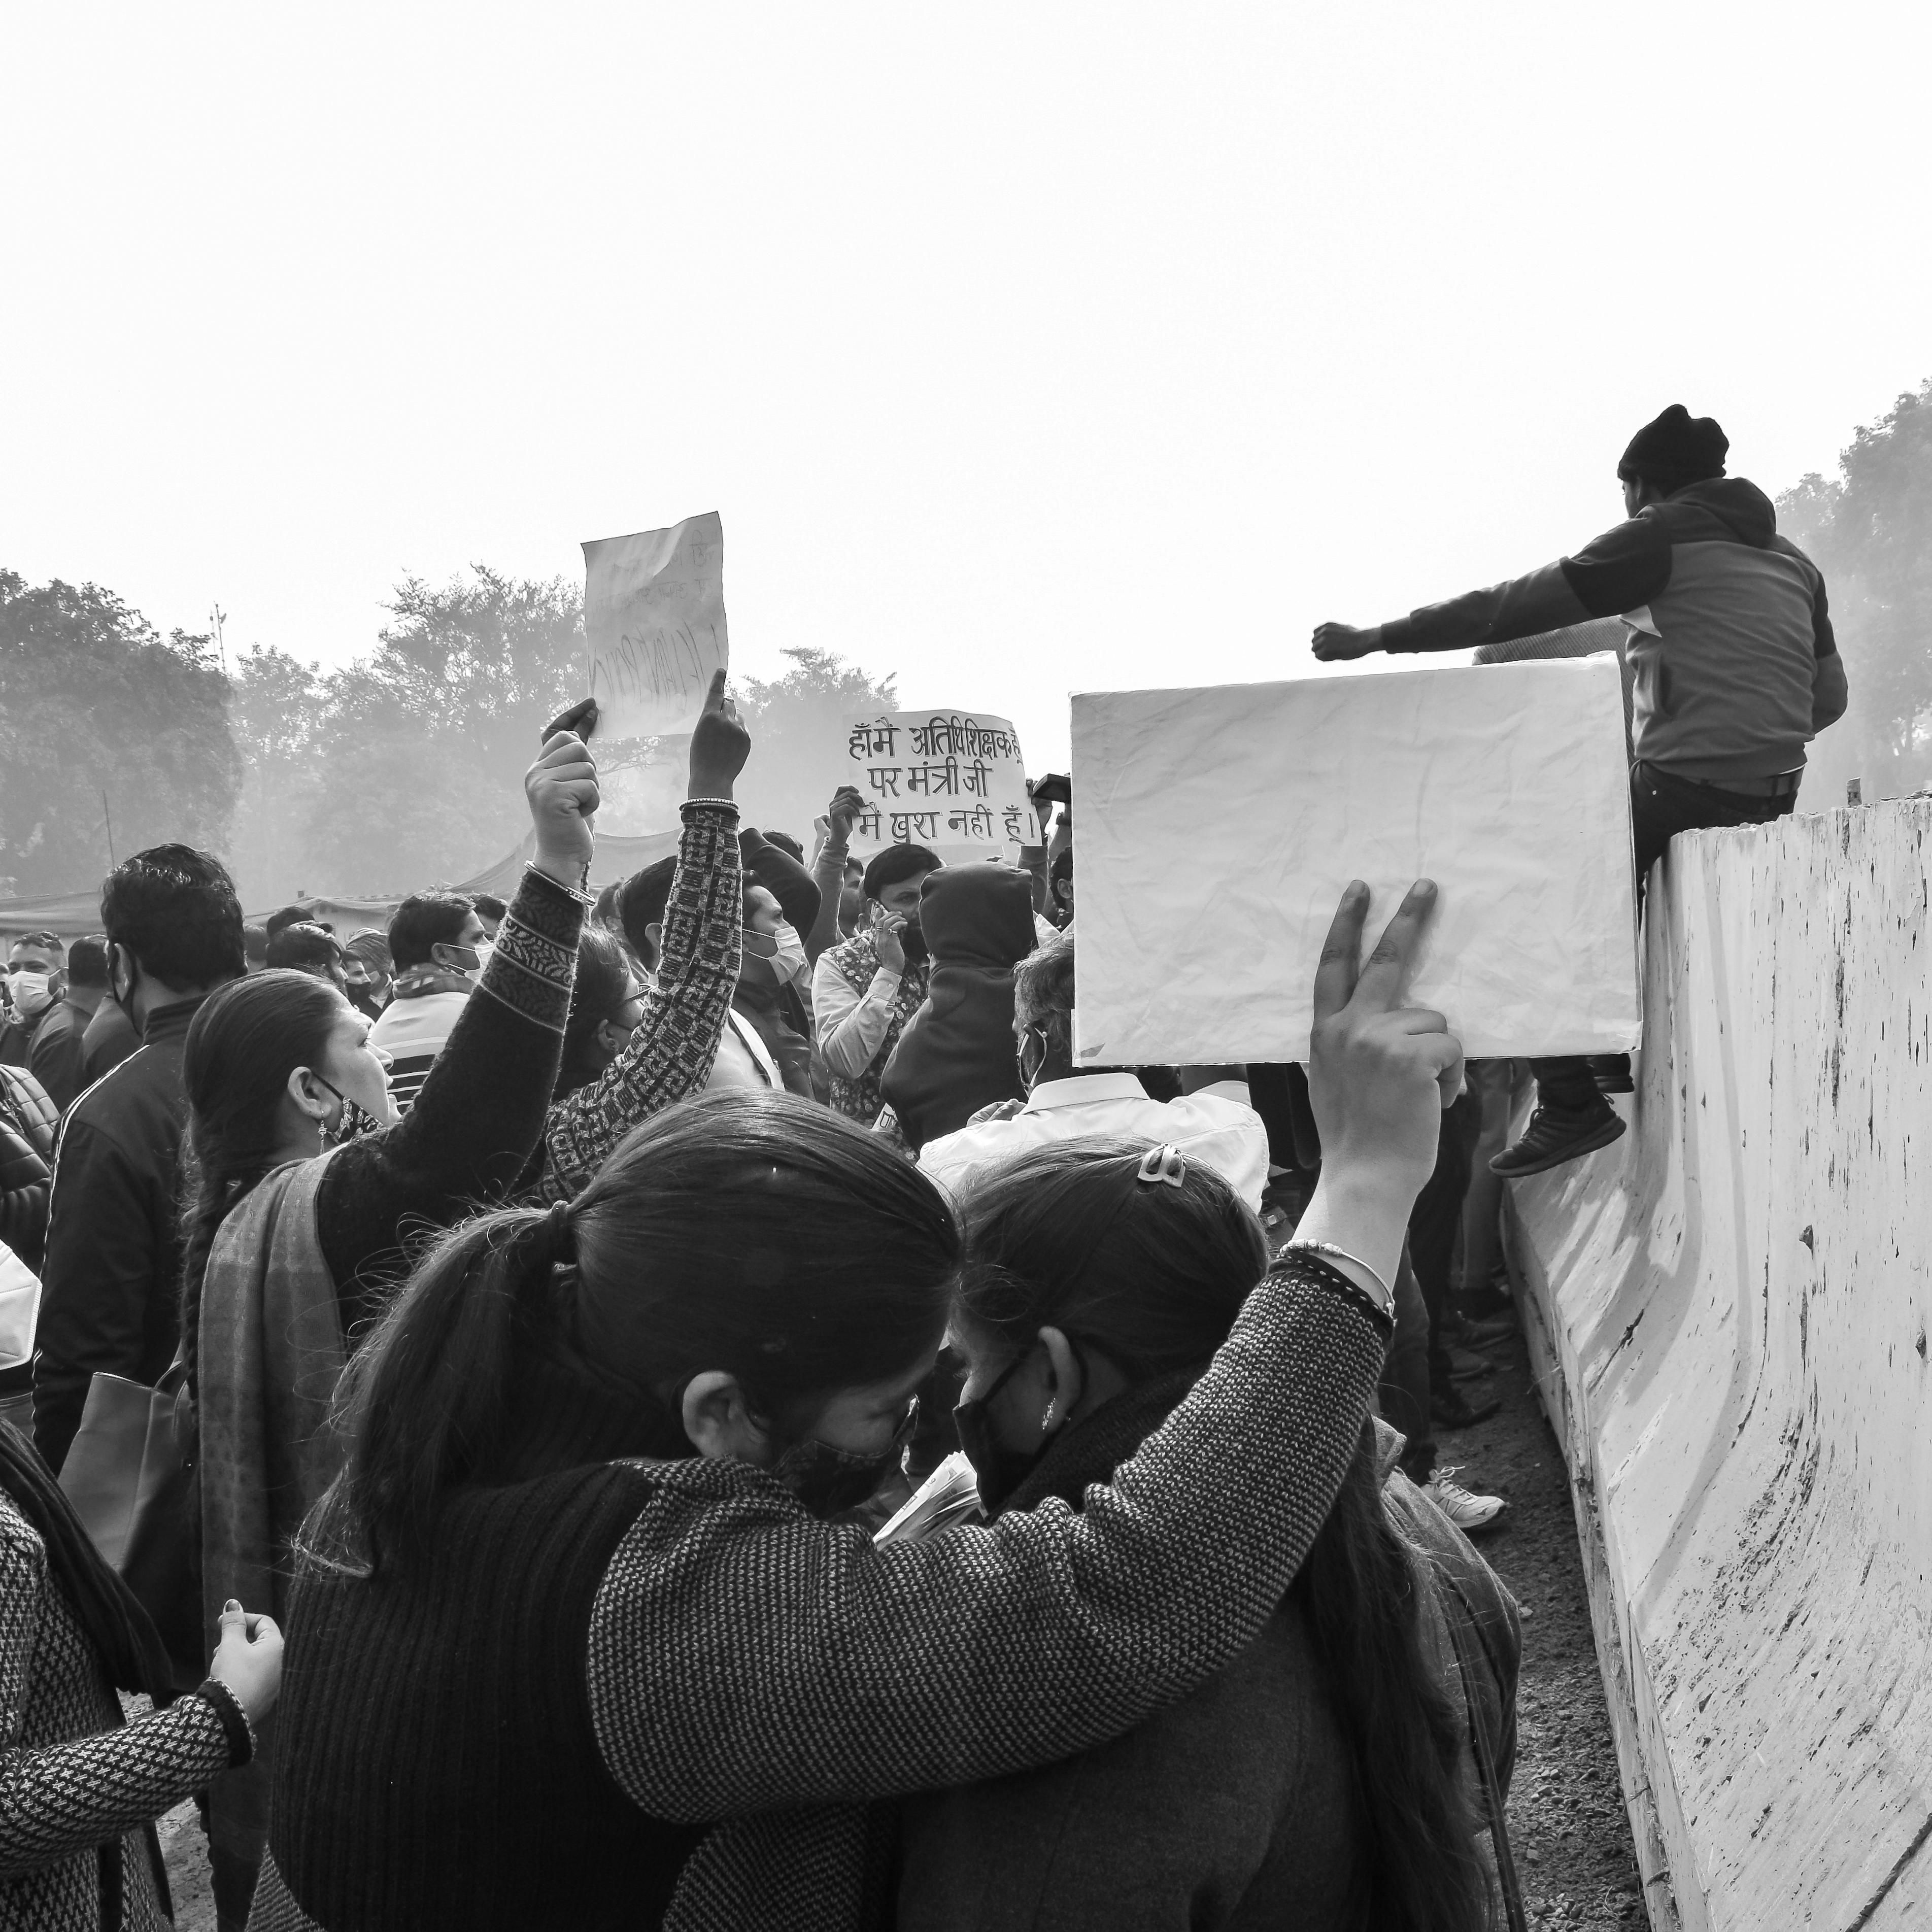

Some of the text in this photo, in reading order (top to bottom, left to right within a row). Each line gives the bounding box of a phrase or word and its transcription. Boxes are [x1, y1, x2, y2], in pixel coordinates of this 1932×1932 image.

[867, 756, 994, 798] पर मंत्री जी
[948, 803, 994, 840] नहीं
